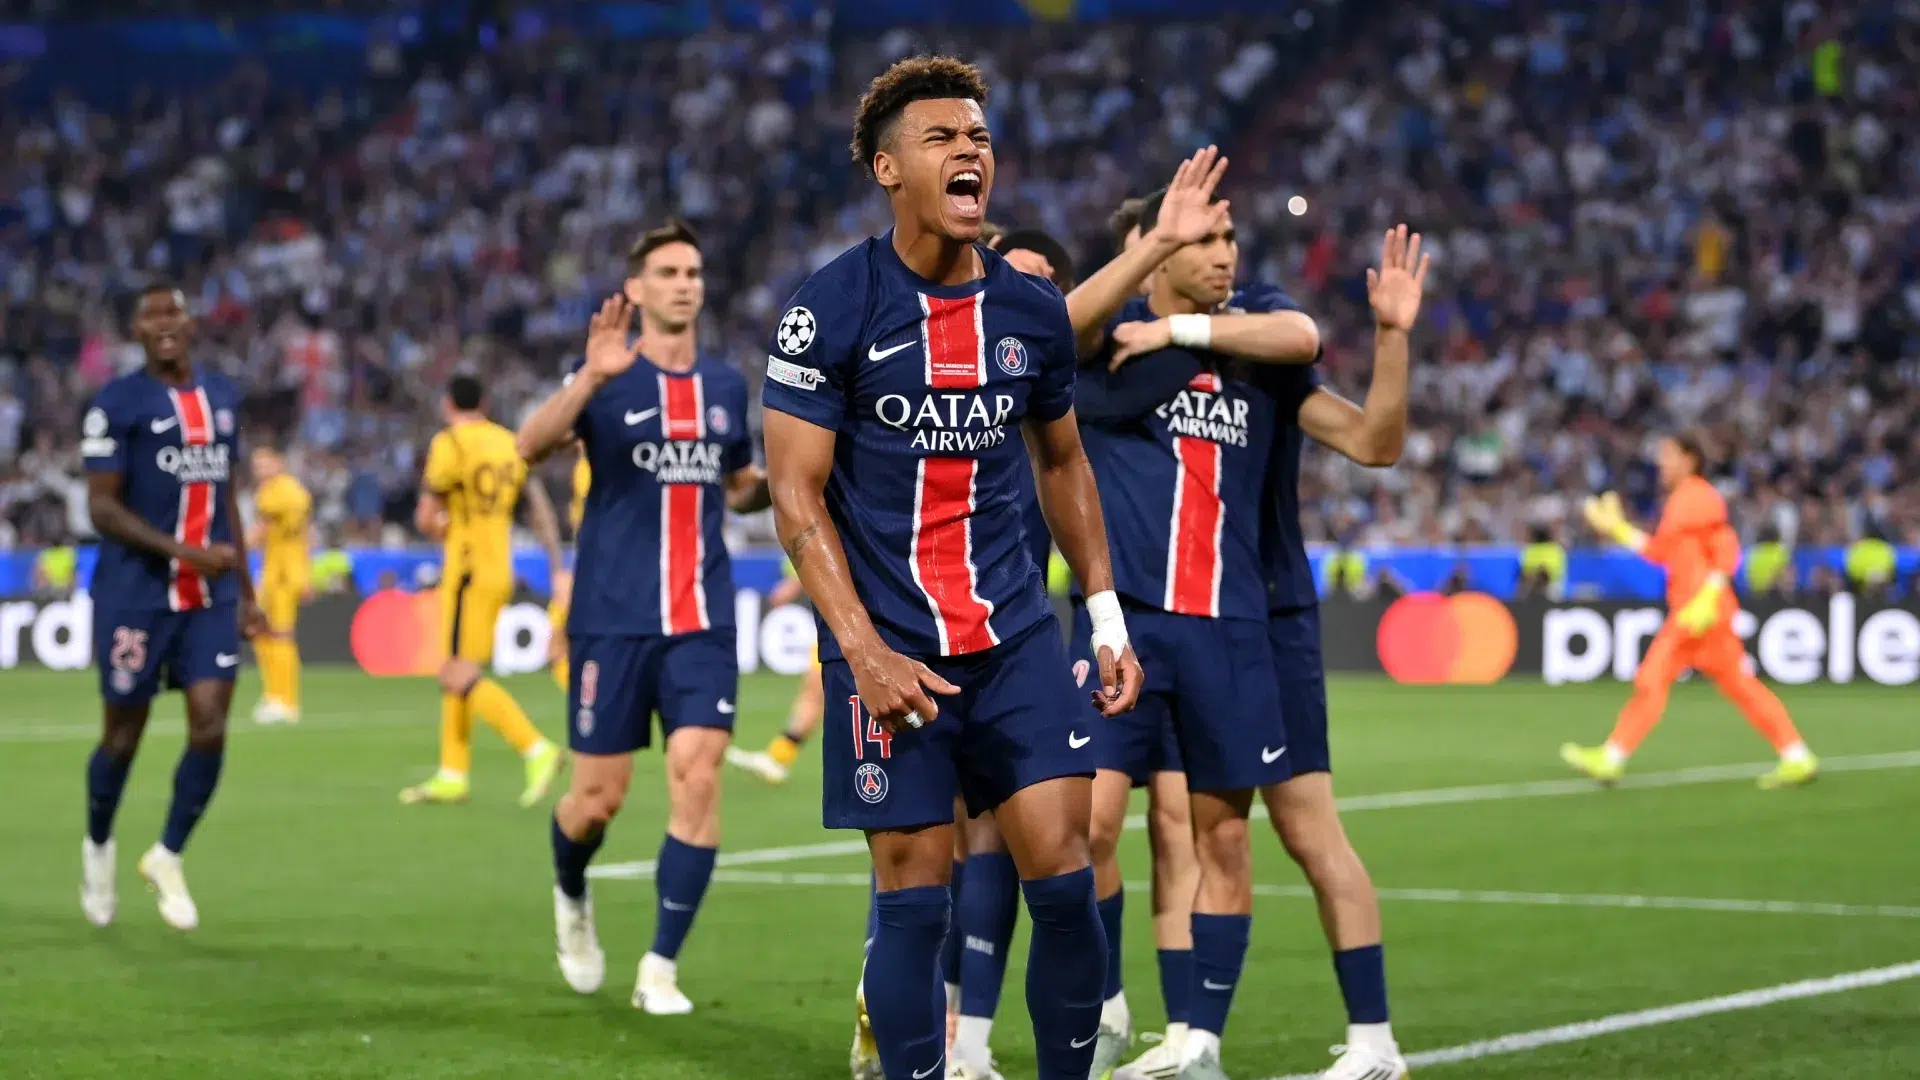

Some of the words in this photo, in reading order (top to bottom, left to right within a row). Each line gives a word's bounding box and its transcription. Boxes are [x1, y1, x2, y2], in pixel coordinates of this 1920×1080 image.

[1001, 340, 1021, 350] PARIS
[875, 394, 1014, 431] QATAR
[911, 425, 1005, 451] AIRWAYS
[1167, 414, 1248, 447] AIRWAYS
[632, 440, 723, 473] QATAR
[848, 694, 892, 760] 14
[858, 765, 880, 776] PARIS
